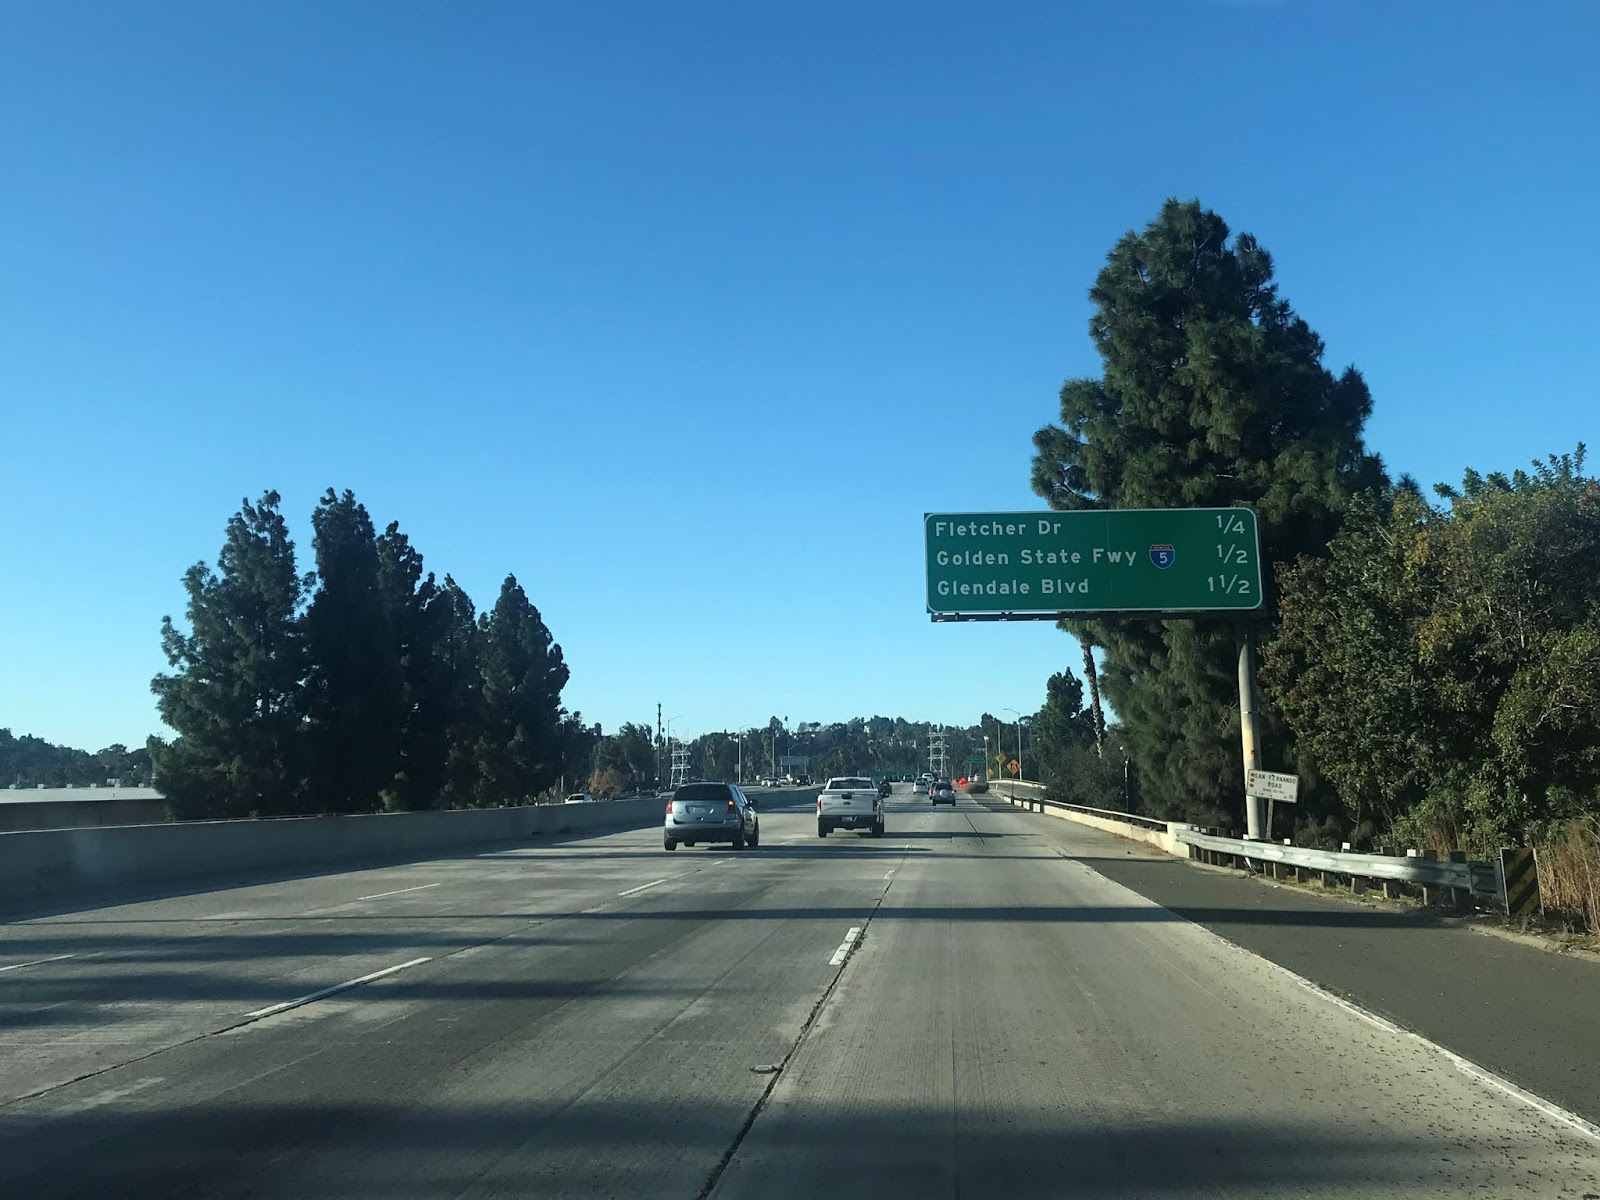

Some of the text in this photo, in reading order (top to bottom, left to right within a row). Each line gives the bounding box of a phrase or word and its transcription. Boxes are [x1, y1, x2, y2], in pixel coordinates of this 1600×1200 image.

[935, 514, 1246, 537] Fletcher Dr 1/4
[936, 544, 1248, 567] Golden State Fwy 5 1/2
[937, 579, 1030, 596] Glendale
[1041, 578, 1089, 594] Blvd
[1267, 781, 1283, 789] ROAD
[1268, 774, 1297, 784] FERNANDO
